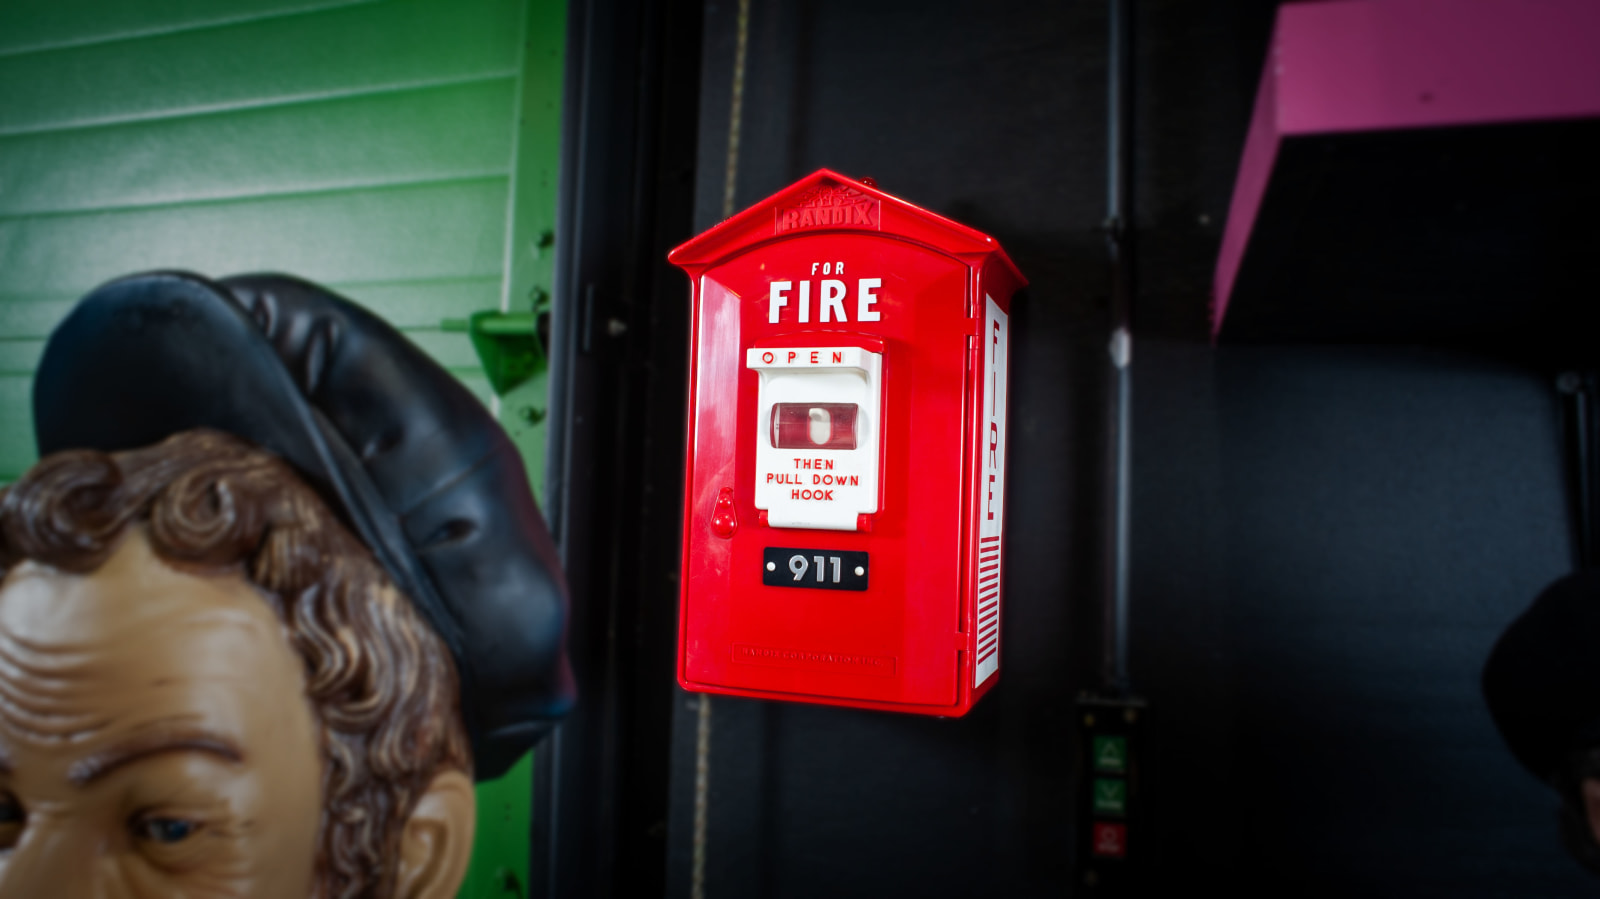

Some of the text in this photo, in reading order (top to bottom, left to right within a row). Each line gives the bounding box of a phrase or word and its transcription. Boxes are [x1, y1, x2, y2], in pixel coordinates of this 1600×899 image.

[782, 202, 873, 231] RANDIX
[811, 261, 845, 276] FOR
[768, 278, 882, 324] FIRE
[762, 351, 842, 364] OPEN
[987, 319, 999, 521] FIRE
[793, 458, 834, 470] THEN
[766, 473, 859, 486] PULL DOWN
[791, 489, 834, 501] HOOK
[788, 554, 842, 583] 911
